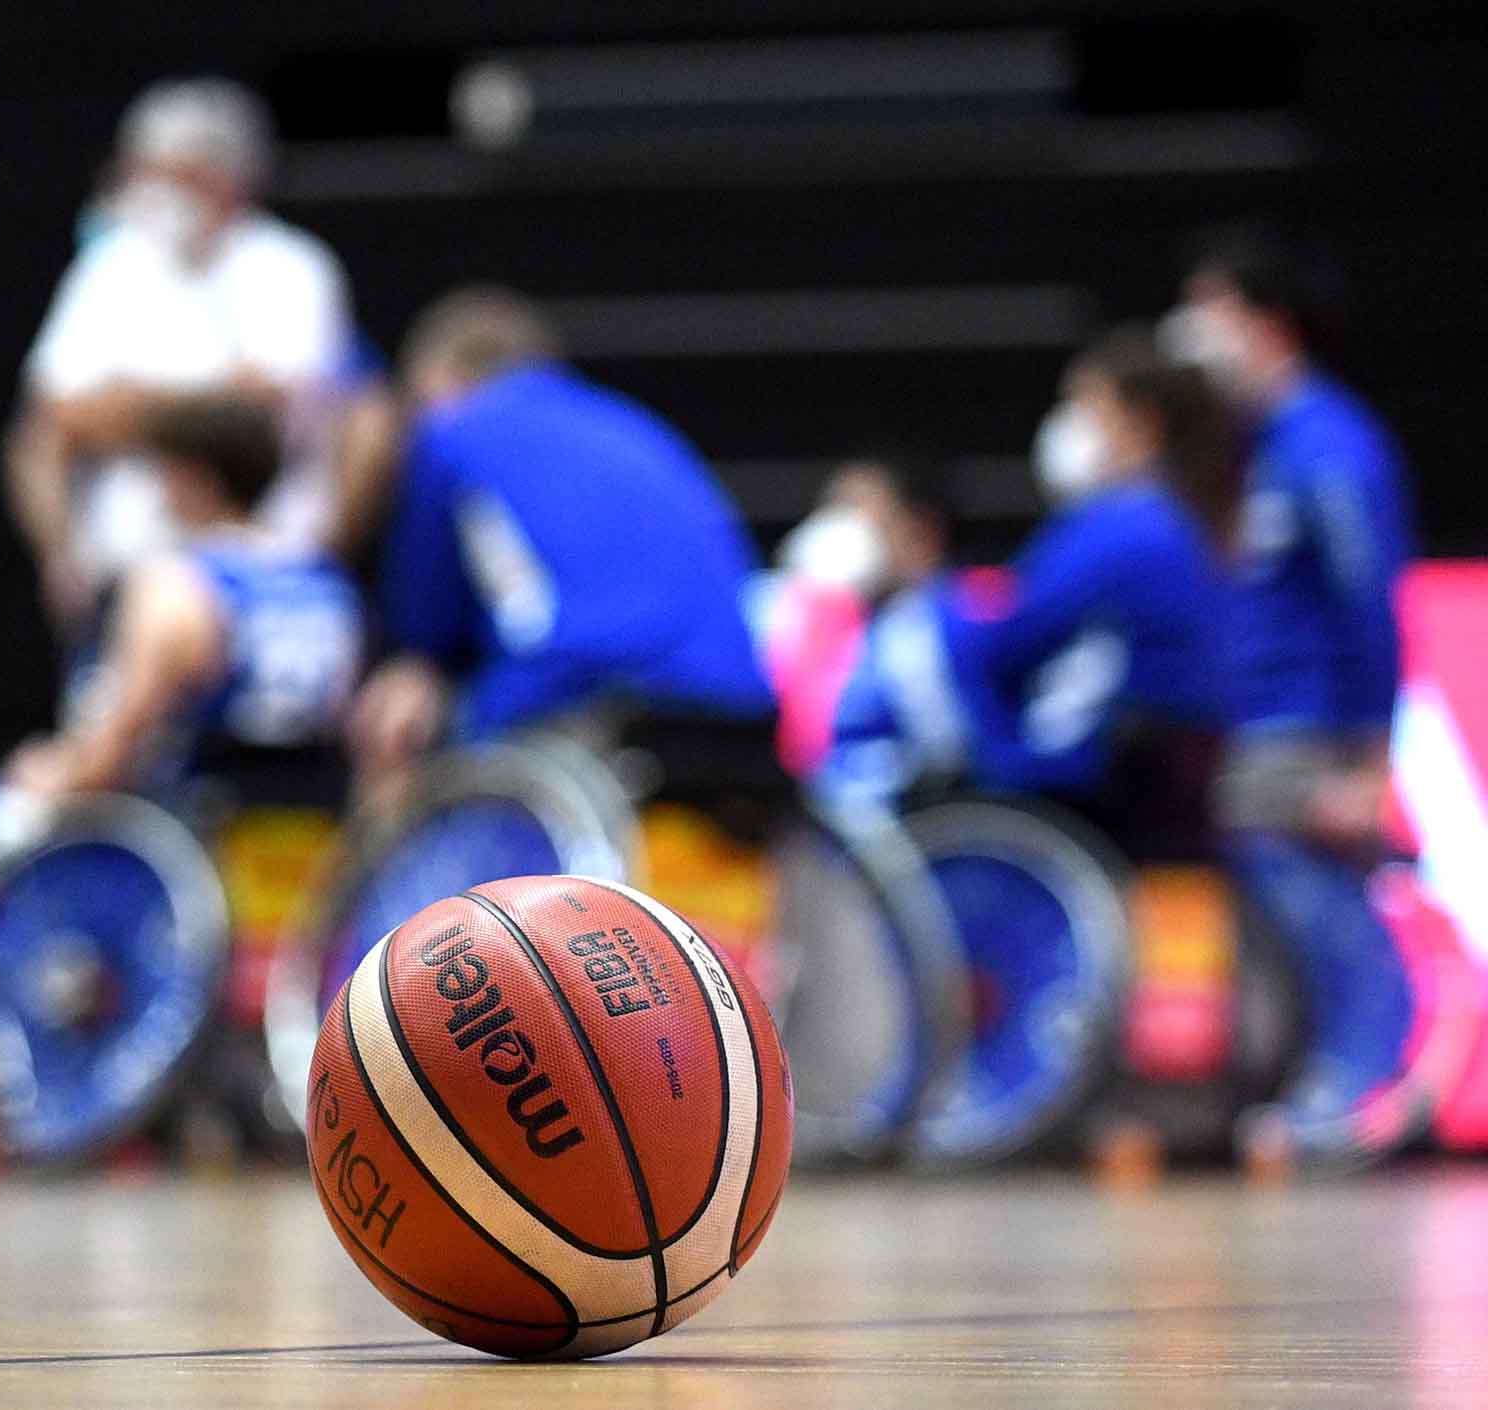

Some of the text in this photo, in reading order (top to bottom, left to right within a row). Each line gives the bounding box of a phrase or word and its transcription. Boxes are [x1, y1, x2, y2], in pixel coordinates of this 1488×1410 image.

[568, 930, 651, 1017] FIBA
[612, 927, 670, 1007] APPROVED
[418, 922, 585, 1160] molten
[328, 1127, 407, 1249] HSV
